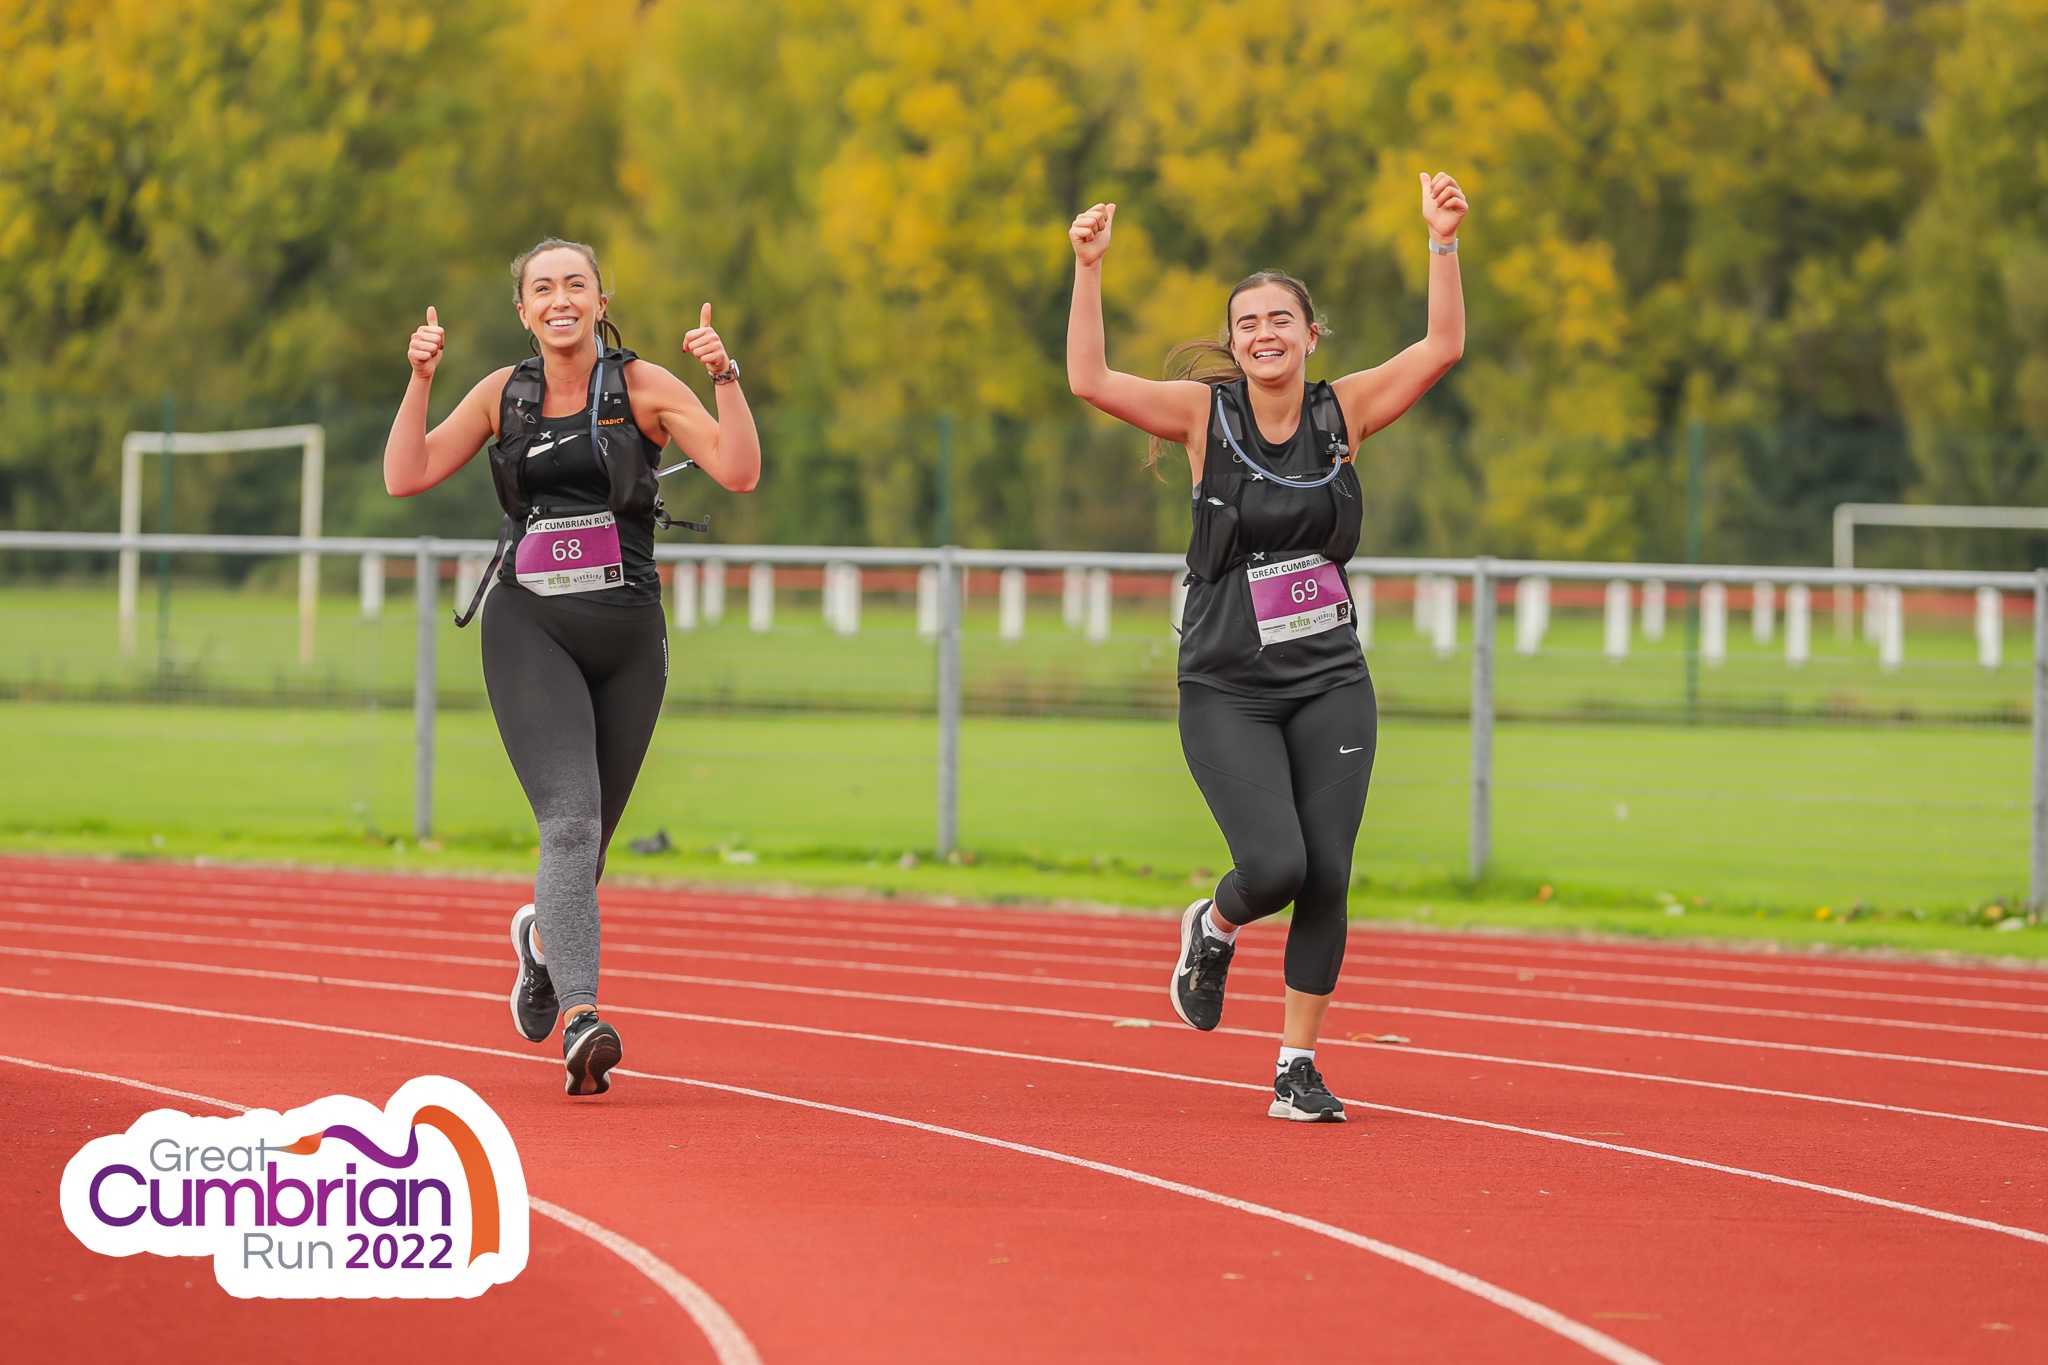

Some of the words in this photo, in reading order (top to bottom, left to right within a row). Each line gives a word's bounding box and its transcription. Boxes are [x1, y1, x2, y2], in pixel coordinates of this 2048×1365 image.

[598, 417, 624, 426] EVADICT
[544, 519, 592, 531] CUMBRIAN
[594, 515, 611, 526] RUN
[552, 538, 582, 561] 68
[1252, 566, 1279, 579] GREAT
[1291, 578, 1318, 603] 69
